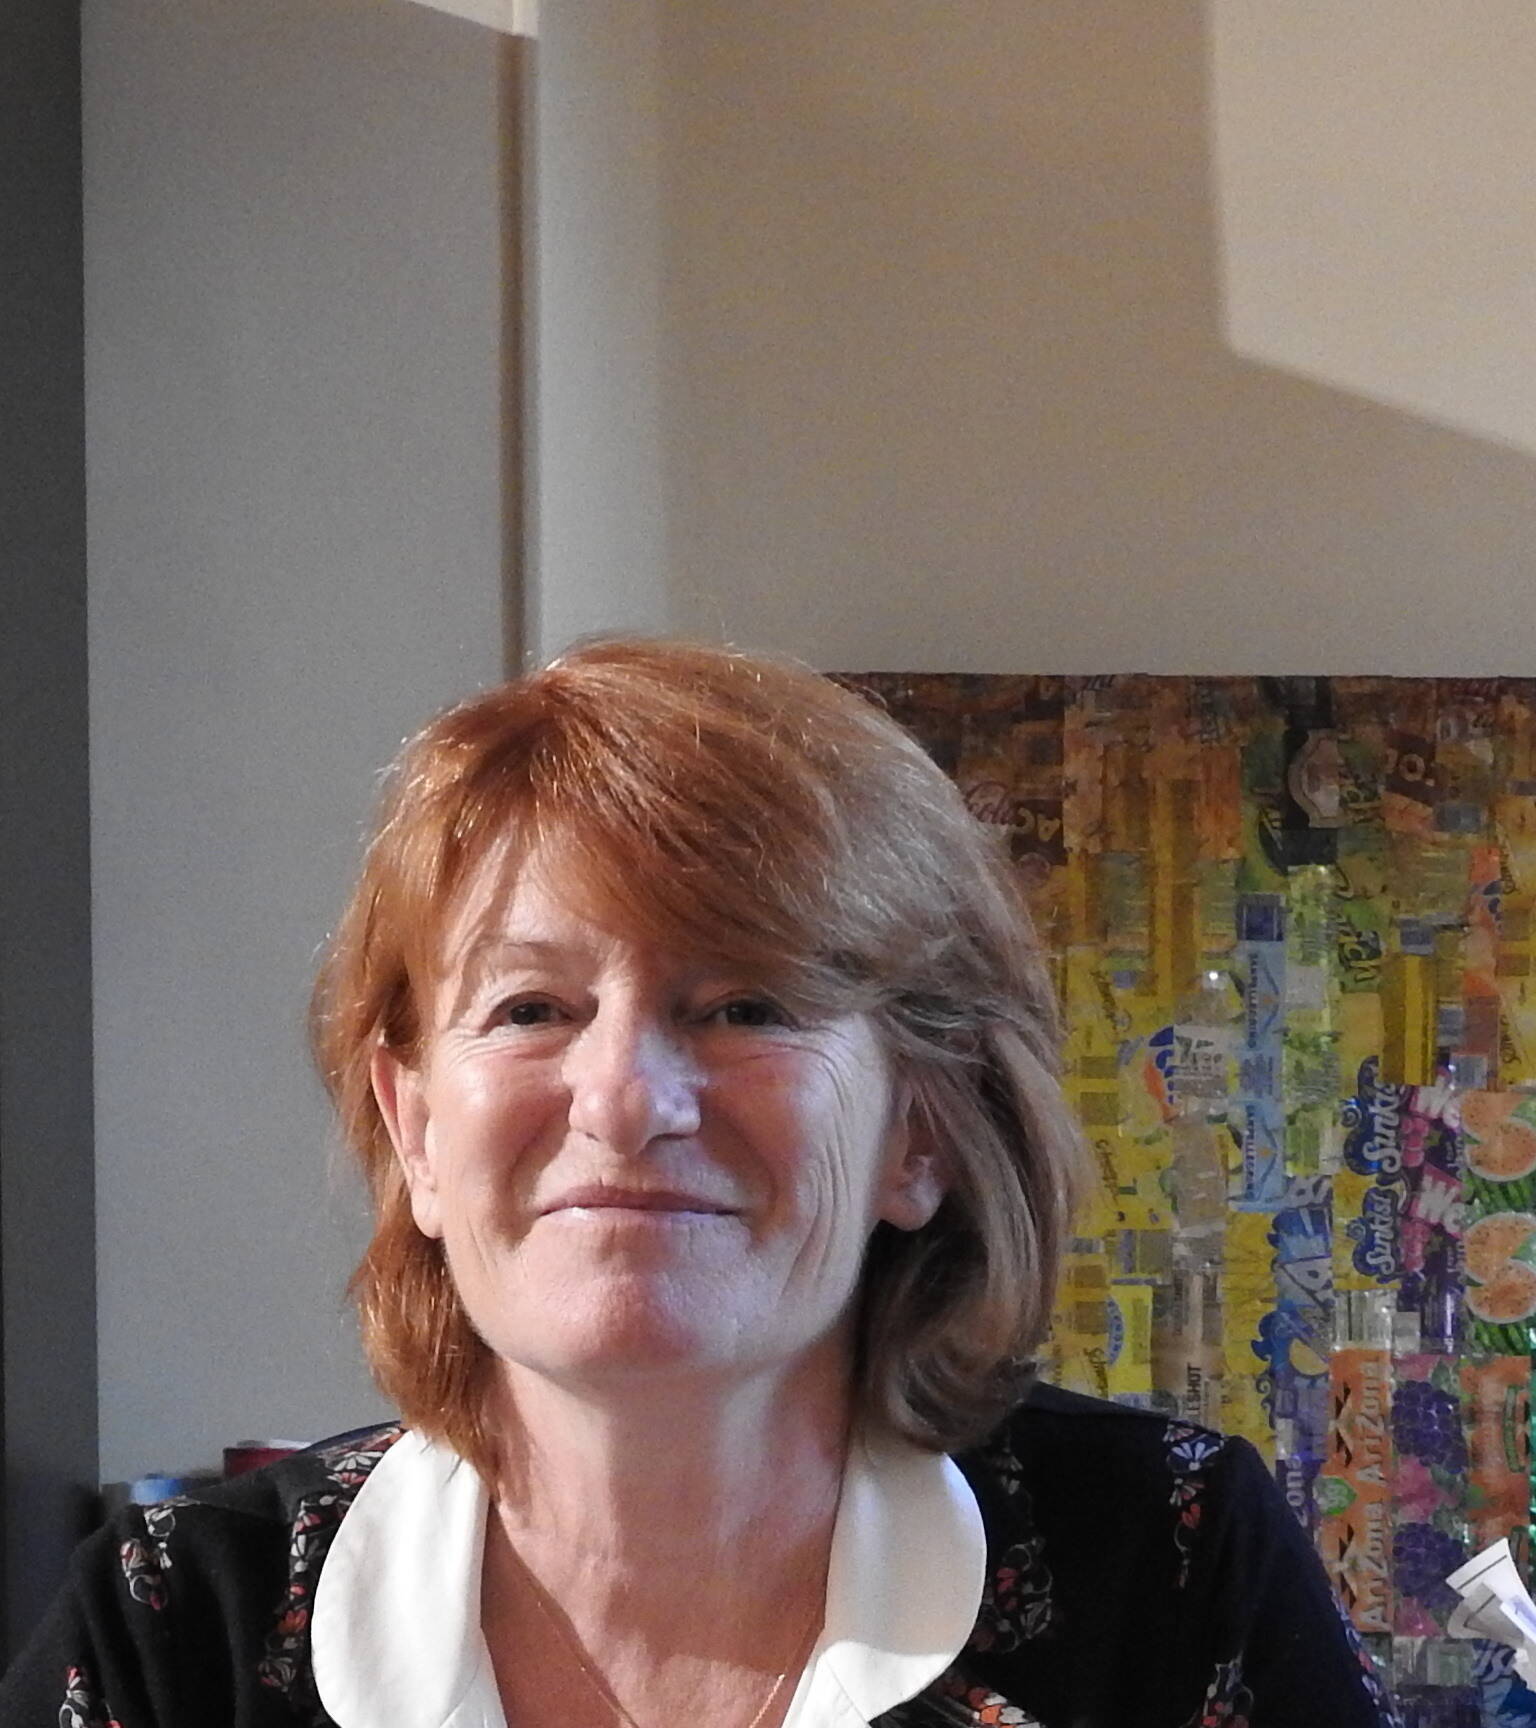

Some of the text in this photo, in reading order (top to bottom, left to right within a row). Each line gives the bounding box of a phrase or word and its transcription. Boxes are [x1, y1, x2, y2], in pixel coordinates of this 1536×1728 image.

[1361, 1062, 1403, 1175] Sunkis
[1354, 1361, 1387, 1486] AriZona
[1356, 1499, 1389, 1632] AriZona
